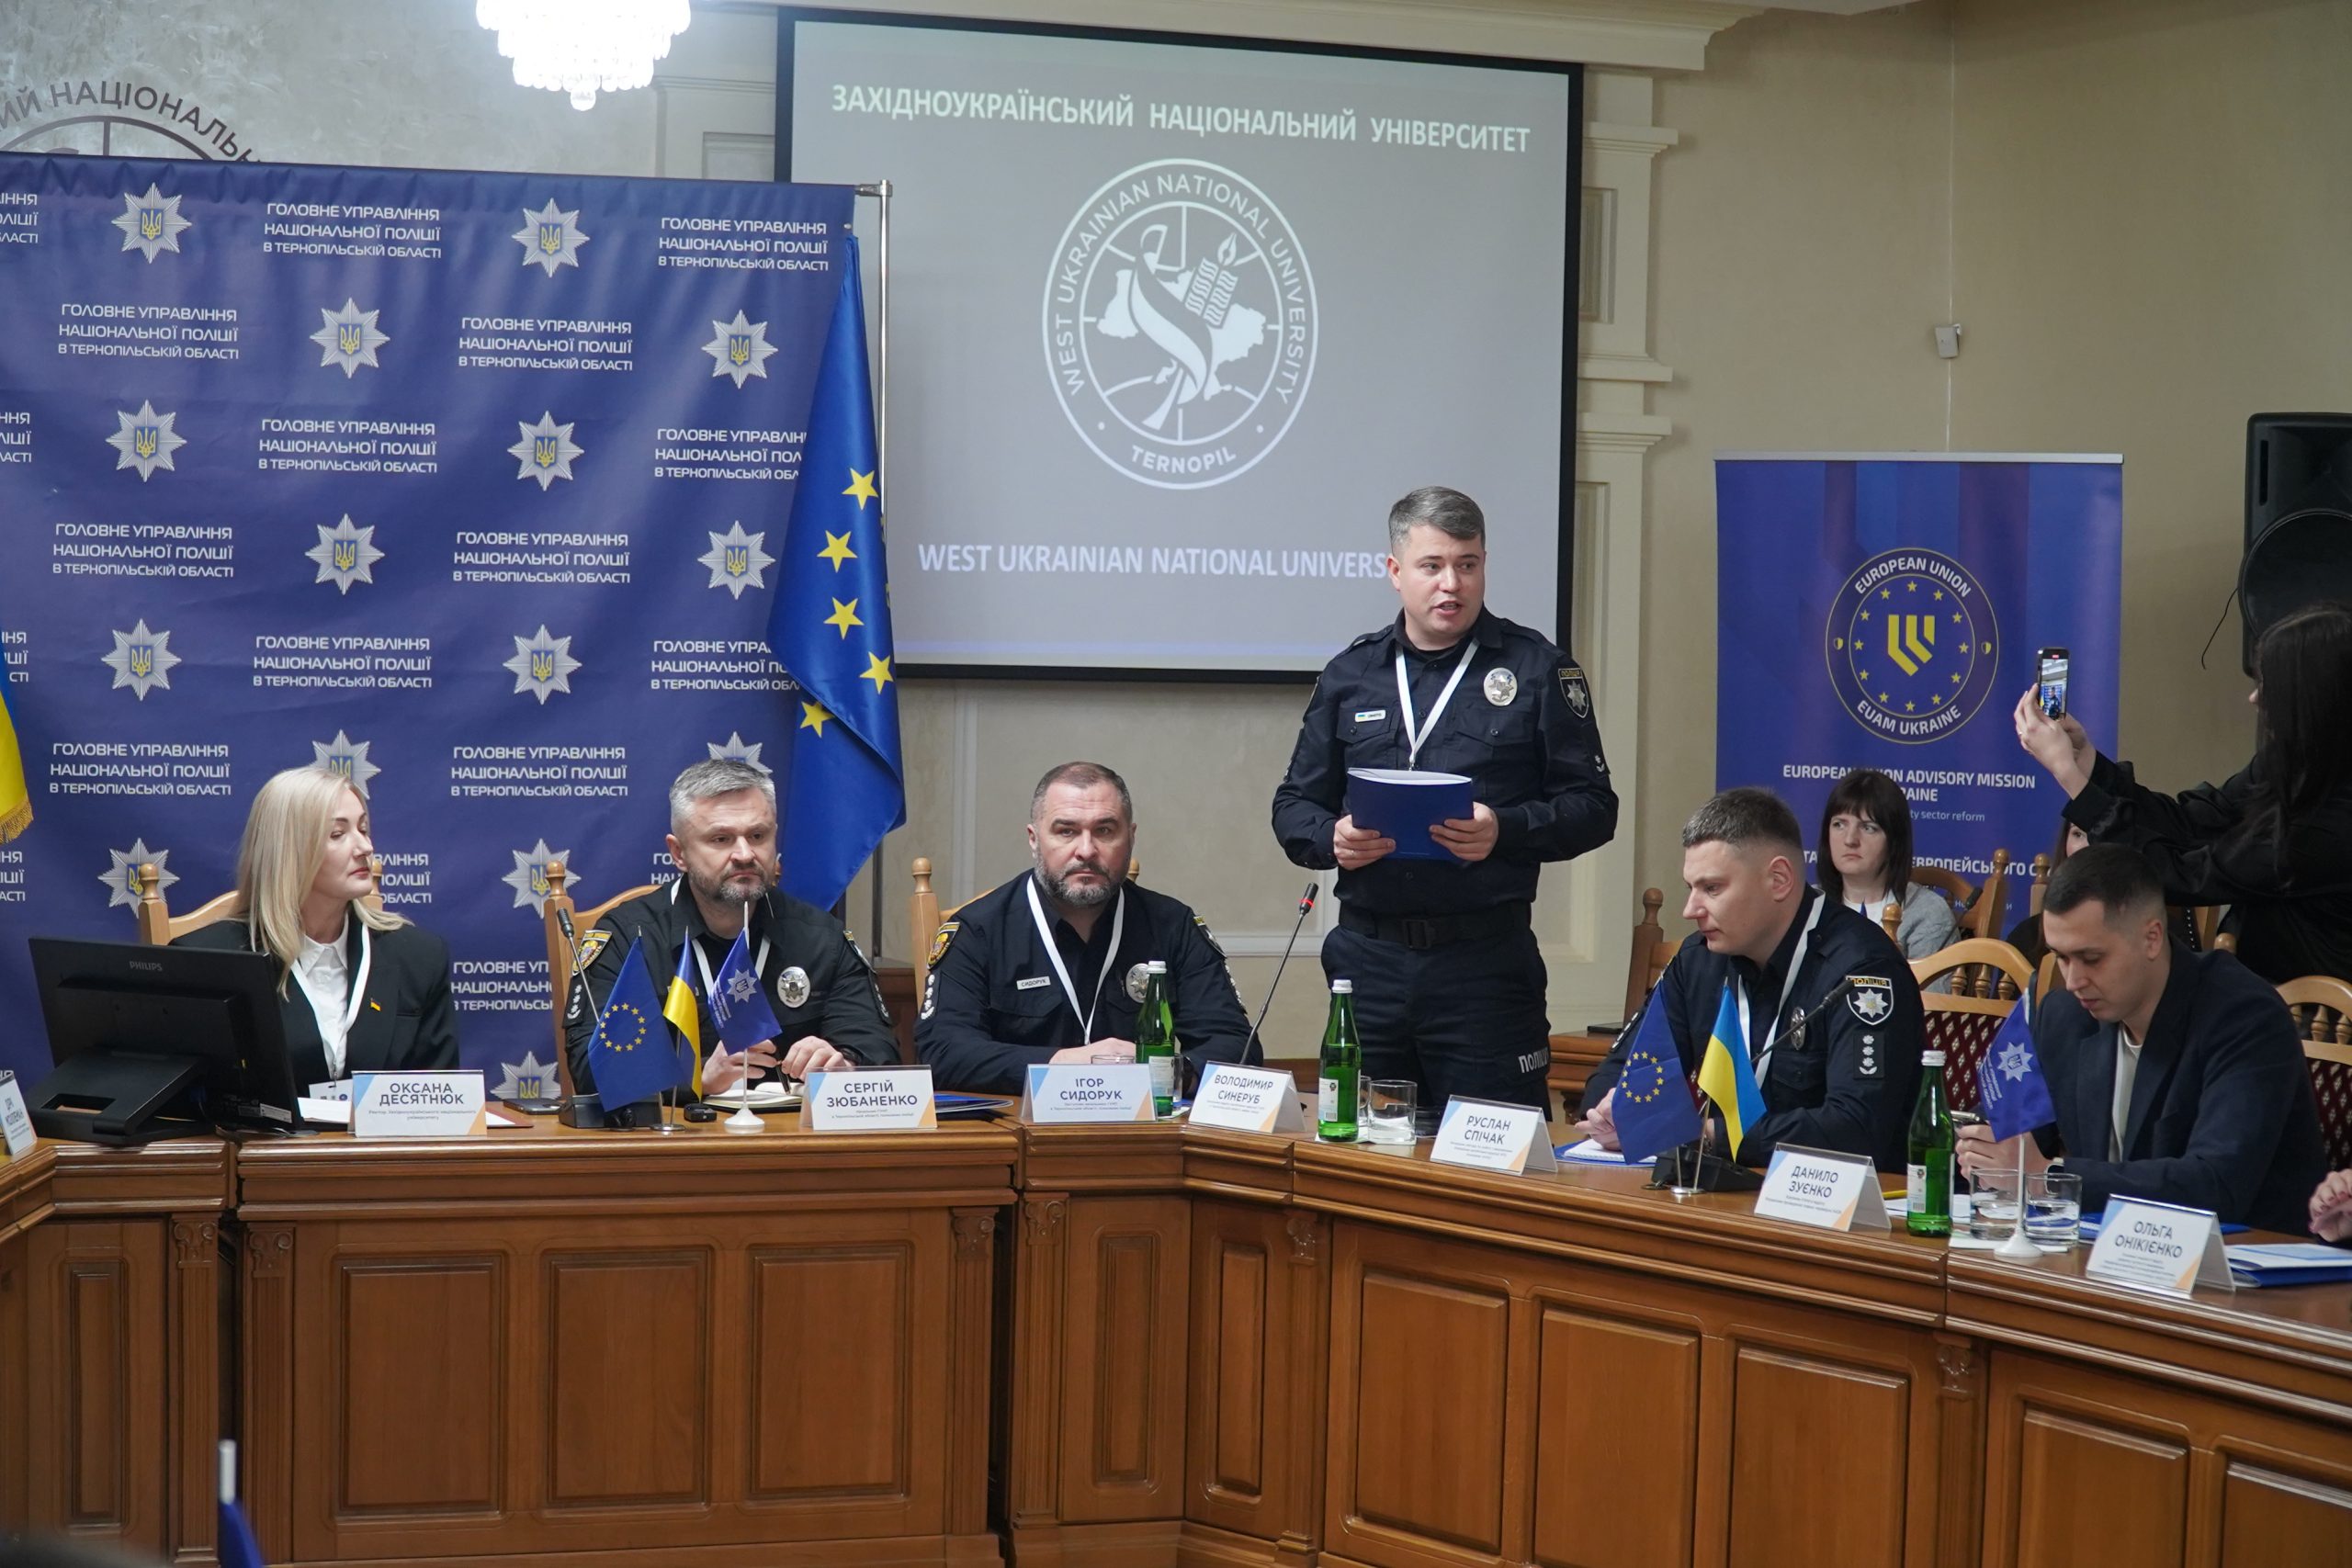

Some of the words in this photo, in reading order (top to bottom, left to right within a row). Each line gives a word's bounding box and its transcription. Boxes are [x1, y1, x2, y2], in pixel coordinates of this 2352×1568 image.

[50, 80, 254, 163] НАЦІОНАЛЬ
[831, 84, 1134, 127] ЗАХІДНОУКРАЇНСЬКИЙ
[1149, 102, 1357, 141] НАЦІОНАЛЬНИЙ
[1370, 116, 1531, 152] УНІВЕРСИТЕТ
[267, 203, 339, 217] ГОЛОВНЕ
[343, 206, 439, 220] УПРАВЛІННЯ
[1157, 174, 1271, 239] NATIONAL
[265, 223, 379, 238] НАЦІОНАЛЬНОЇ
[385, 228, 440, 241] ПОЛІЦІЇ
[662, 218, 730, 231] ГОЛОВНЕ
[734, 220, 826, 234] УПРАВЛІННЯ
[660, 238, 769, 252] НАЦІОНАЛЬНОЇ
[775, 241, 828, 254] ПОЛІЦІЇ
[1057, 179, 1149, 304] UKRAINIAN
[264, 243, 272, 252] В
[275, 243, 385, 255] ТЕРНОПІЛЬСЬКІЙ
[388, 247, 441, 258] ОБЛАСТІ
[659, 256, 666, 265] В
[669, 256, 775, 269] ТЕРНОПІЛЬСЬКІЙ
[777, 260, 828, 271] ОБЛАСТІ
[62, 304, 134, 318] ГОЛОВНЕ
[139, 307, 236, 321] УПРАВЛІННЯ
[462, 318, 534, 331] ГОЛОВНЕ
[537, 320, 631, 333] УПРАВЛІННЯ
[1270, 238, 1306, 405] UNIVERSITY
[60, 324, 177, 339] НАЦІОНАЛЬНОЇ
[182, 328, 238, 342] ПОЛІЦІЇ
[59, 344, 67, 354] В
[70, 344, 181, 357] ТЕРНОПІЛЬСЬКІЙ
[185, 348, 238, 359] ОБЛАСТІ
[459, 338, 574, 352] НАЦІОНАЛЬНОЇ
[579, 340, 632, 353] ПОЛІЦІЇ
[1056, 312, 1086, 396] WEST
[458, 356, 468, 366] В
[470, 356, 578, 368] ТЕРНОПІЛЬСЬКІЙ
[582, 359, 632, 370] ОБЛАСТІ
[262, 419, 334, 433] ГОЛОВНЕ
[338, 422, 435, 434] УПРАВЛІННЯ
[658, 429, 727, 441] ГОЛОВНЕ
[730, 431, 807, 443] УПРАВЛІН
[260, 440, 377, 454] НАЦІОНАЛЬНОЇ
[381, 441, 436, 455] ПОЛІЦІЇ
[656, 449, 767, 462] НАЦІОНАЛЬНОЇ
[1131, 445, 1238, 474] TERNOPIL
[259, 458, 267, 468] В
[270, 459, 380, 471] ТЕРНОПІЛЬСЬКІЙ
[383, 462, 436, 472] ОБЛАСТІ
[655, 468, 663, 477] В
[666, 468, 772, 479] ТЕРНОПІЛЬСЬКІЙ
[56, 524, 130, 536] ГОЛОВНЕ
[133, 525, 232, 539] УПРАВЛІННЯ
[457, 532, 528, 545] ГОЛОВНЕ
[531, 534, 628, 546] УПРАВЛІННЯ
[53, 544, 172, 558] НАЦІОНАЛЬНОЇ
[176, 546, 233, 559] ПОЛІЦІЇ
[454, 552, 570, 565] НАЦІОНАЛЬНОЇ
[574, 552, 629, 566] ПОЛІЦІЇ
[919, 544, 991, 571] WEST
[999, 545, 1143, 574] UKRAINIAN
[1152, 547, 1278, 576] NATIONAL
[1282, 550, 1387, 579] UNIVERS
[53, 563, 62, 573] В
[64, 564, 175, 576] ТЕРНОПІЛЬСЬКІЙ
[178, 566, 233, 577] ОБЛАСТІ
[453, 571, 462, 581] В
[465, 571, 574, 582] ТЕРНОПІЛЬСЬКІЙ
[577, 572, 630, 583] ОБЛАСТІ
[1854, 557, 1927, 594] EUROPEAN
[1929, 560, 1972, 597] UNION
[256, 637, 329, 649] ГОЛОВНЕ
[332, 637, 429, 650] УПРАВЛІННЯ
[654, 641, 725, 652] ГОЛОВНЕ
[254, 656, 370, 670] НАЦІОНАЛЬНОЇ
[375, 657, 431, 671] ПОЛІЦІЇ
[651, 660, 765, 672] НАЦІОНАЛЬНОЇ
[254, 676, 262, 686] В
[265, 676, 375, 687] ТЕРНОПІЛЬСЬКІЙ
[378, 677, 432, 688] ОБЛАСТІ
[651, 680, 660, 689] В
[662, 679, 769, 690] ТЕРНОПІЛЬСЬКІЙ
[1857, 700, 1895, 732] EUAM
[1899, 705, 1962, 735] UKRAINE
[53, 743, 127, 756] ГОЛОВНЕ
[130, 744, 228, 757] УПРАВЛІННЯ
[454, 747, 526, 759] ГОЛОВНЕ
[528, 747, 625, 759] УПРАВЛІННЯ
[51, 763, 169, 777] НАЦІОНАЛЬНОЇ
[174, 763, 230, 777] ПОЛІЦІЇ
[452, 766, 567, 779] НАЦІОНАЛЬНОЇ
[571, 765, 627, 779] ПОЛІЦІЇ
[1783, 764, 1855, 779] EUROPEA
[1906, 770, 1974, 785] ADVISORY
[1977, 773, 2035, 789] MISSION
[50, 783, 58, 793] В
[62, 784, 174, 795] ТЕРНОПІЛЬСЬКІЙ
[176, 784, 231, 795] ОБЛАСТІ
[451, 786, 460, 795] В
[462, 785, 571, 795] ТЕРНОПІЛЬСЬКІЙ
[574, 786, 628, 796] ОБЛАСТІ
[1921, 810, 1950, 820] sector
[1952, 811, 1984, 822] reform
[381, 871, 431, 886] ОЛІЦІЇ
[130, 961, 163, 972] PHILIPS
[453, 961, 526, 975] ГОЛОВНЕ
[450, 980, 552, 994] НАЦІОНАЛЬН
[460, 999, 553, 1011] ТЕРНОПІЛЬСЬ
[390, 1083, 453, 1094] ОКСАНА
[844, 1079, 894, 1093] СЕРГІЙ
[1076, 1078, 1104, 1088] ІГОР
[1214, 1075, 1273, 1090] ВОЛОДИМИР
[379, 1093, 464, 1106] ДЕСЯТНЮК
[827, 1095, 917, 1107] ЗЮБАНЕНКО
[1060, 1090, 1122, 1101] СИДОРУК
[1217, 1090, 1261, 1104] СИНЕРУБ
[1466, 1115, 1511, 1131] РУСЛАН
[1464, 1130, 1505, 1145] СПІЧАК
[1791, 1166, 1838, 1183] ДАНИЛО
[1789, 1180, 1832, 1198] ЗУЄНКО
[2133, 1221, 2173, 1239] ОЛЬГА
[2115, 1235, 2183, 1258] ОНІКІЄНКО
